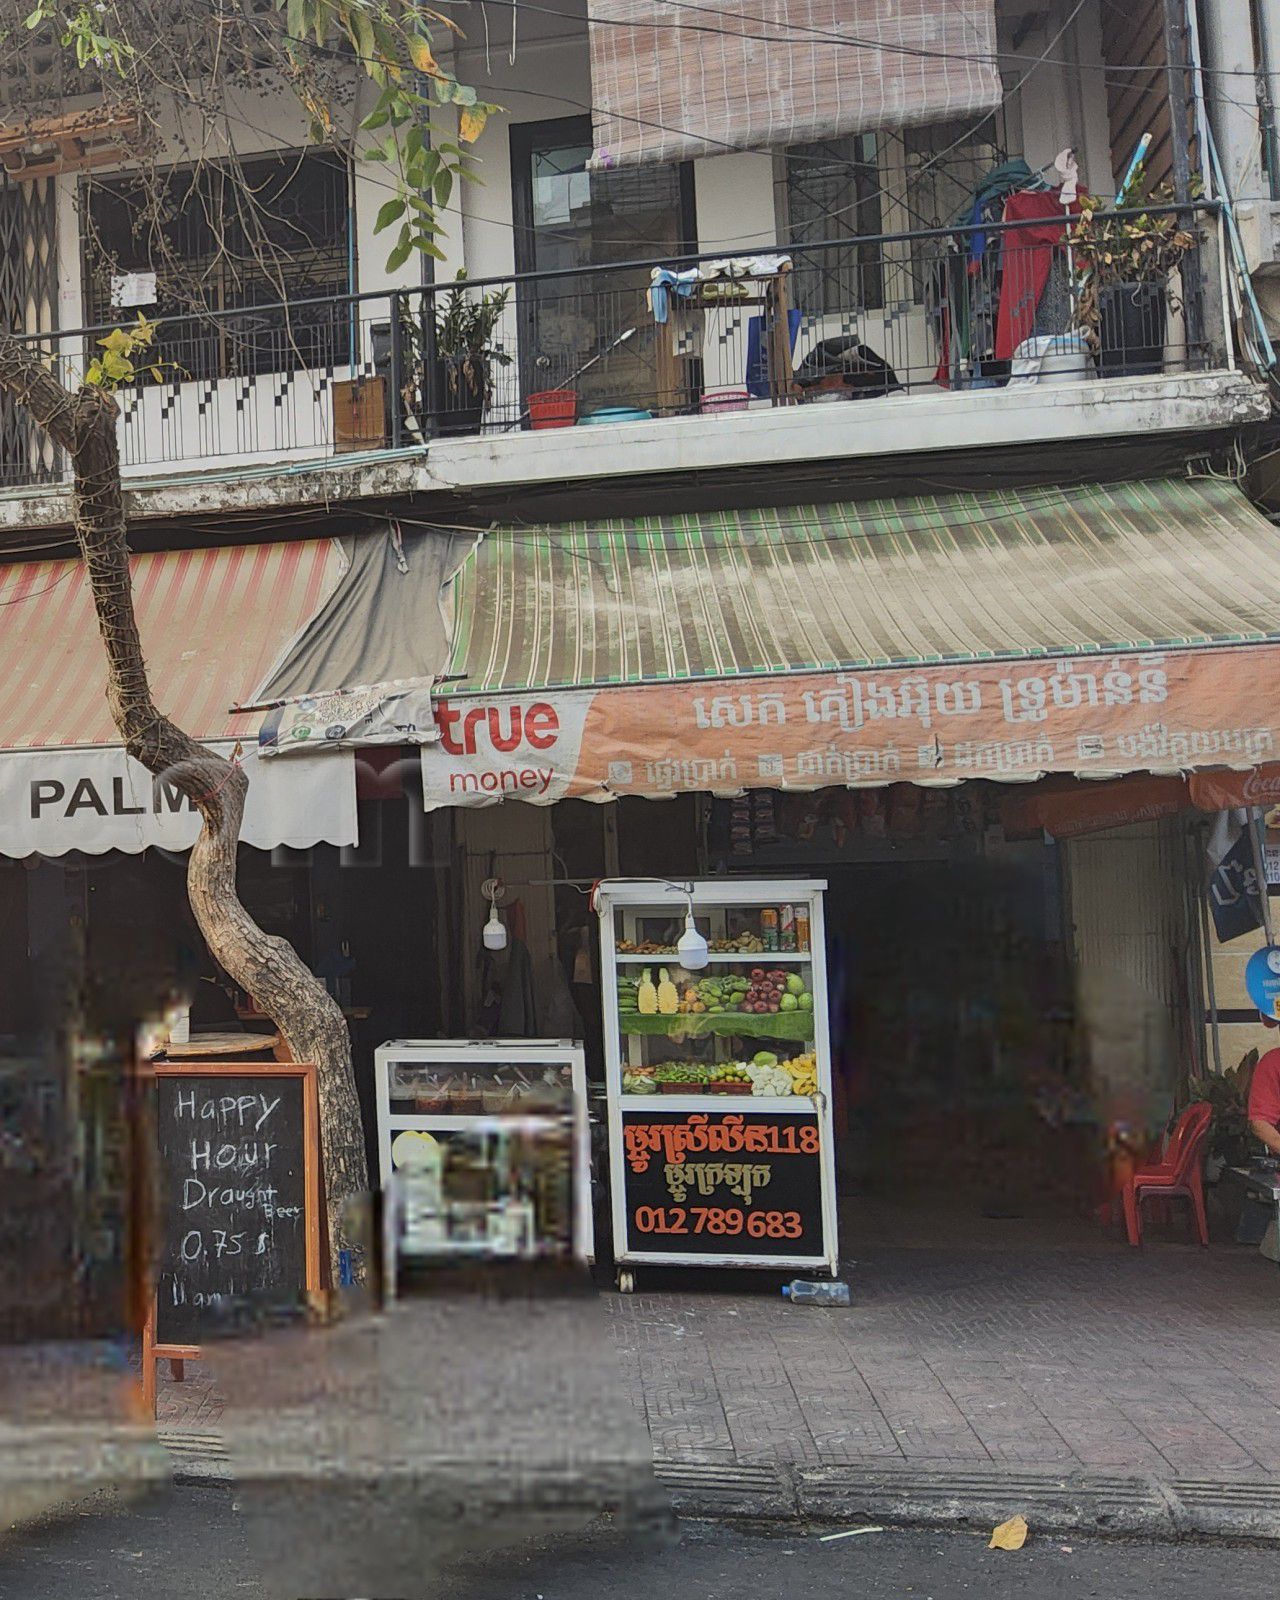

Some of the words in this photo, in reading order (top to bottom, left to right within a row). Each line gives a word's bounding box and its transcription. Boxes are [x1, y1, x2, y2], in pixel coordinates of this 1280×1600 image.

[433, 698, 561, 756] true
[449, 766, 554, 795] money
[177, 1089, 281, 1132] Happy
[191, 1138, 278, 1171] Hour
[635, 1205, 688, 1234] 012
[690, 1206, 744, 1236] 789
[747, 1211, 803, 1239] 683
[181, 1229, 248, 1261] 0.75
